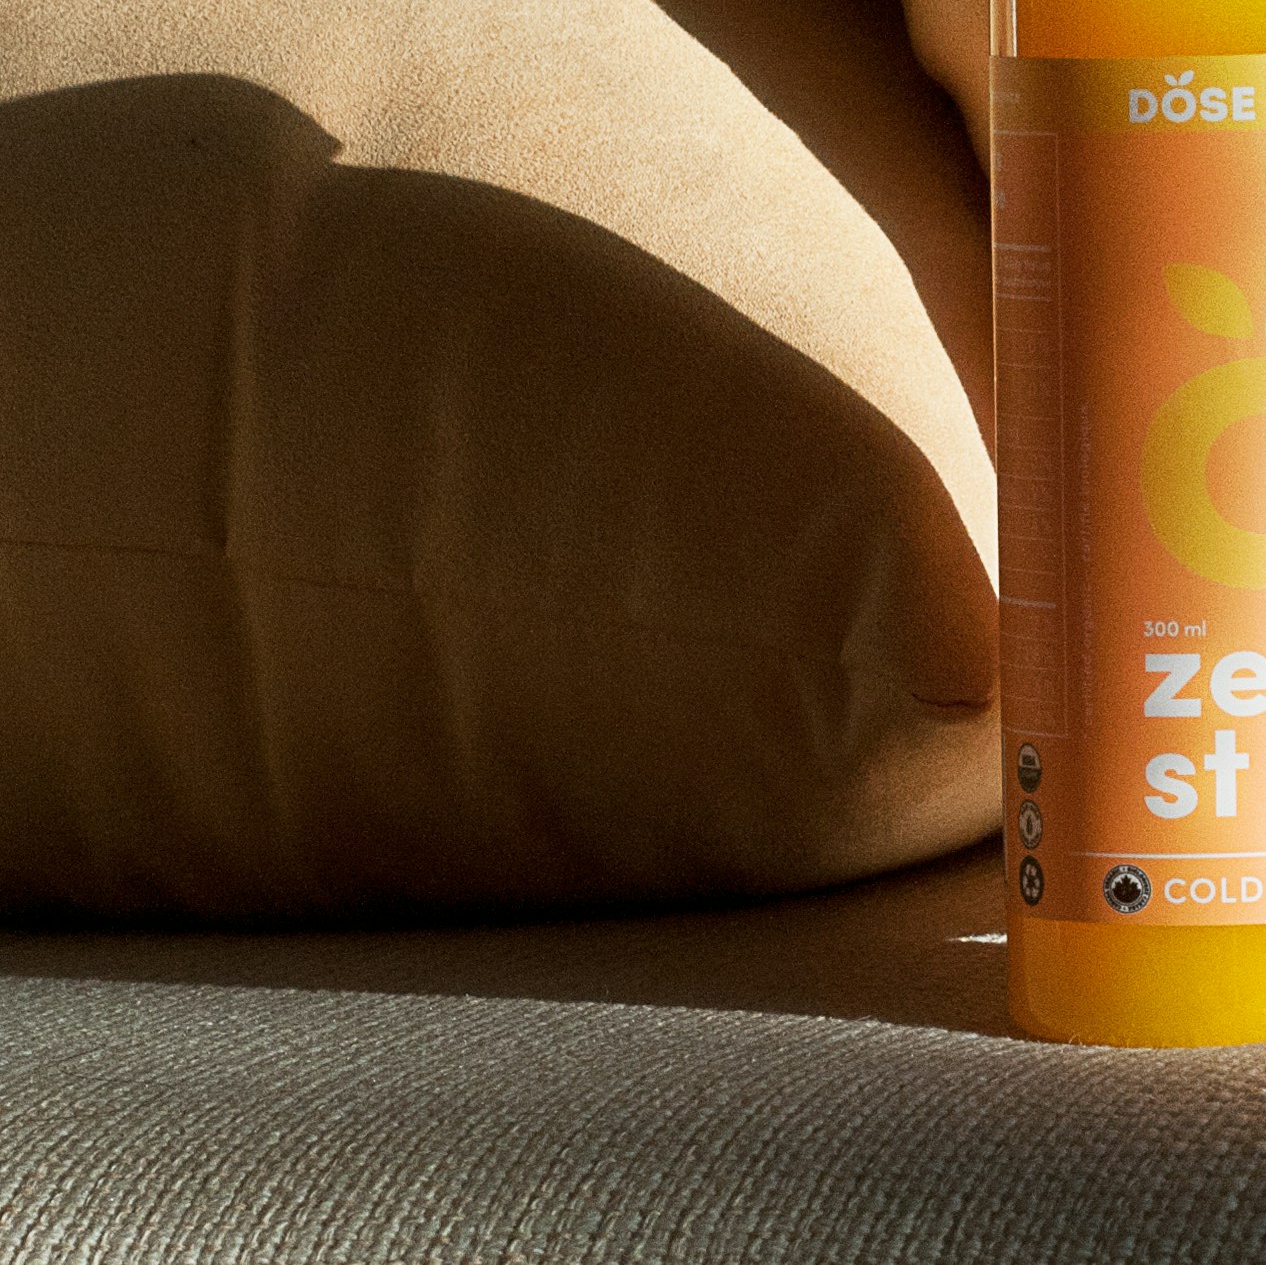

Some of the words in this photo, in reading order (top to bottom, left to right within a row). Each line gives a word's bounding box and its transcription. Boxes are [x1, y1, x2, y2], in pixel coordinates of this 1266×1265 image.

[1144, 621, 1179, 638] 300
[1184, 621, 1207, 638] ml
[1144, 730, 1250, 819] st
[1164, 876, 1264, 904] COLD
